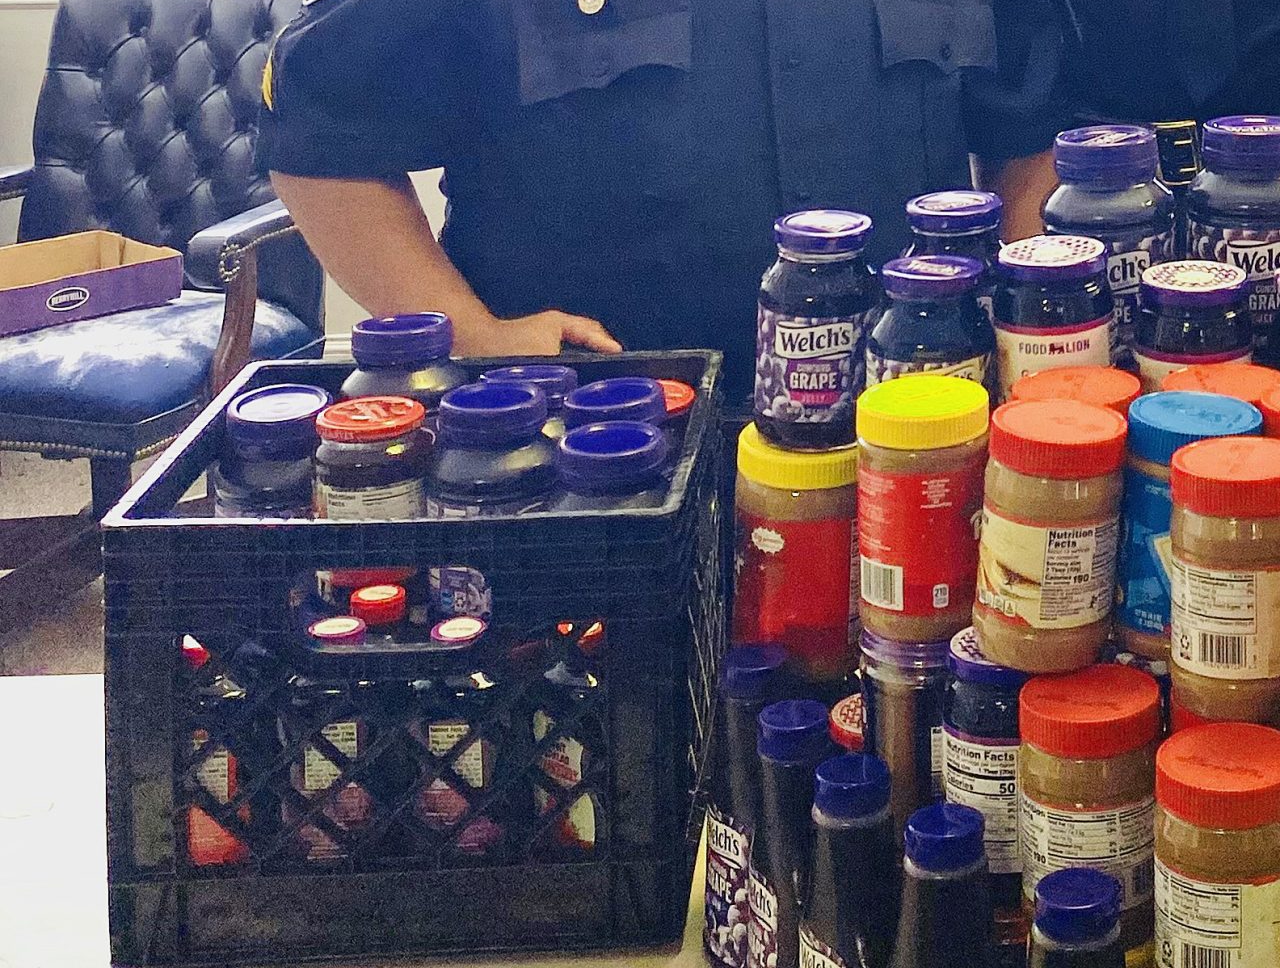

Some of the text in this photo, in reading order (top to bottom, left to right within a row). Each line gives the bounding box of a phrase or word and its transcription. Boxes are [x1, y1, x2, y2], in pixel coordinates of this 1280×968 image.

[1109, 255, 1147, 282] ch's
[780, 326, 851, 352] Welch's
[1019, 339, 1090, 355] FOOD LION
[790, 372, 837, 390] GRAPE
[1049, 530, 1093, 540] Nutrition
[1048, 540, 1077, 548] Facts
[983, 751, 1015, 761] Facts
[999, 782, 1016, 793] 50
